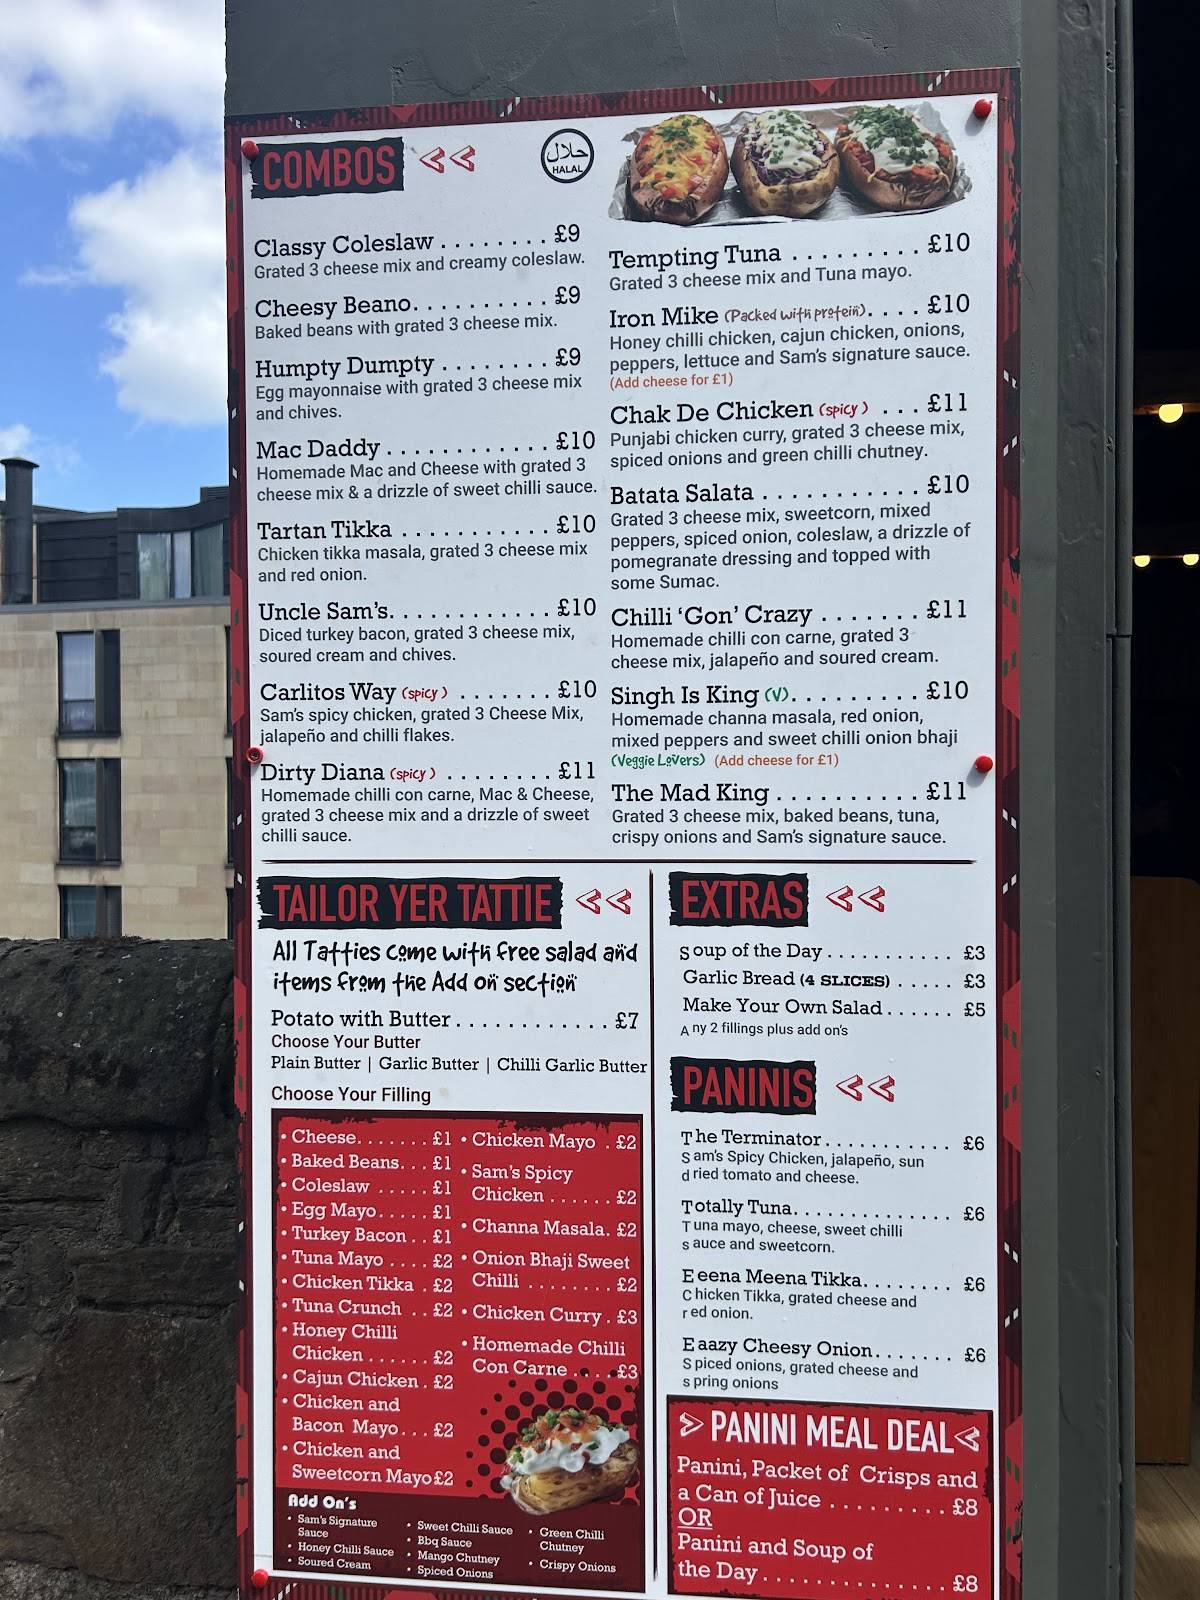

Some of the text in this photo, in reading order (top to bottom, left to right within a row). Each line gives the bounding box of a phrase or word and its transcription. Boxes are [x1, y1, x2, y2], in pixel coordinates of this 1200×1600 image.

[263, 145, 396, 190] COMBOS
[552, 164, 583, 175] HALAL
[254, 223, 579, 260] Classy Coleslaw £9
[608, 232, 970, 272] Tempting Tuna £10
[609, 309, 655, 328] Iron
[661, 306, 718, 326] Mike
[780, 306, 811, 323] with
[927, 293, 969, 314] £10
[255, 347, 580, 381] Humpty Dumpty £9
[609, 372, 733, 391] (Add cheese for £1)
[610, 404, 671, 424] Chak
[676, 403, 709, 422] De
[716, 399, 814, 421] Chicken
[927, 392, 967, 412] £11
[256, 430, 595, 461] Mac Daddy £10
[610, 474, 969, 504] Batata Salata £10
[256, 514, 595, 540] Tartan Tikka £10
[258, 540, 587, 561] Chicken tikka masala, grated 3 cheese mix
[258, 567, 367, 582] and red onion.
[611, 607, 672, 626] Chilli
[744, 604, 813, 627] Crazy
[926, 599, 966, 619] £11
[611, 648, 938, 671] cheese mix, jalapeño and soured cream.
[260, 682, 345, 701] Carlitos
[348, 682, 396, 705] Way
[557, 679, 596, 698] £10
[611, 680, 968, 710] Singh Is King (V) £10
[714, 754, 743, 768] (Add
[747, 754, 792, 766] cheese
[796, 753, 814, 765] for
[817, 753, 838, 767] £1)
[260, 763, 315, 786] Dirty
[321, 762, 385, 780] Diana
[558, 761, 595, 779] £11
[660, 783, 710, 801] Mad
[716, 782, 769, 806] King
[926, 781, 966, 800] £11
[273, 884, 552, 922] TAILOR YER TATTIE
[682, 880, 803, 919] EXTRAS
[273, 939, 638, 967] All Tatties come with free salad and
[683, 969, 985, 988] Garlic Bread (4 SLICES) £3
[682, 996, 985, 1017] Make Your Own Salad £5
[271, 1009, 638, 1029] Potato with Butter £7
[684, 1066, 812, 1108] PANINIS
[721, 1129, 822, 1147] Terminator
[963, 1135, 984, 1151] £6
[291, 1153, 451, 1170] Baked Beans £1
[291, 1225, 451, 1244] Turkey Bacon £1
[472, 1217, 539, 1234] Channa
[616, 1222, 636, 1237] £2
[711, 1410, 954, 1453] PANINI MEAL DEAL
[677, 1455, 978, 1490] Panini, Packet of Crisps and
[288, 1493, 356, 1510] Add On's
[297, 1513, 377, 1528] Sam's Signature
[417, 1520, 513, 1535] Sweet Chilli Sauce
[678, 1507, 712, 1528] OR
[297, 1526, 328, 1538] Sauce
[417, 1535, 472, 1548] Bbq Sauce
[539, 1527, 604, 1540] Green Chilli
[298, 1541, 394, 1556] Honey Chilli Sauce
[417, 1550, 500, 1566] Mango Chutney
[539, 1540, 584, 1555] Chutney
[297, 1555, 371, 1569] Soured Cream
[417, 1564, 493, 1579] Spiced Onions
[539, 1558, 616, 1572] Crispy Onions
